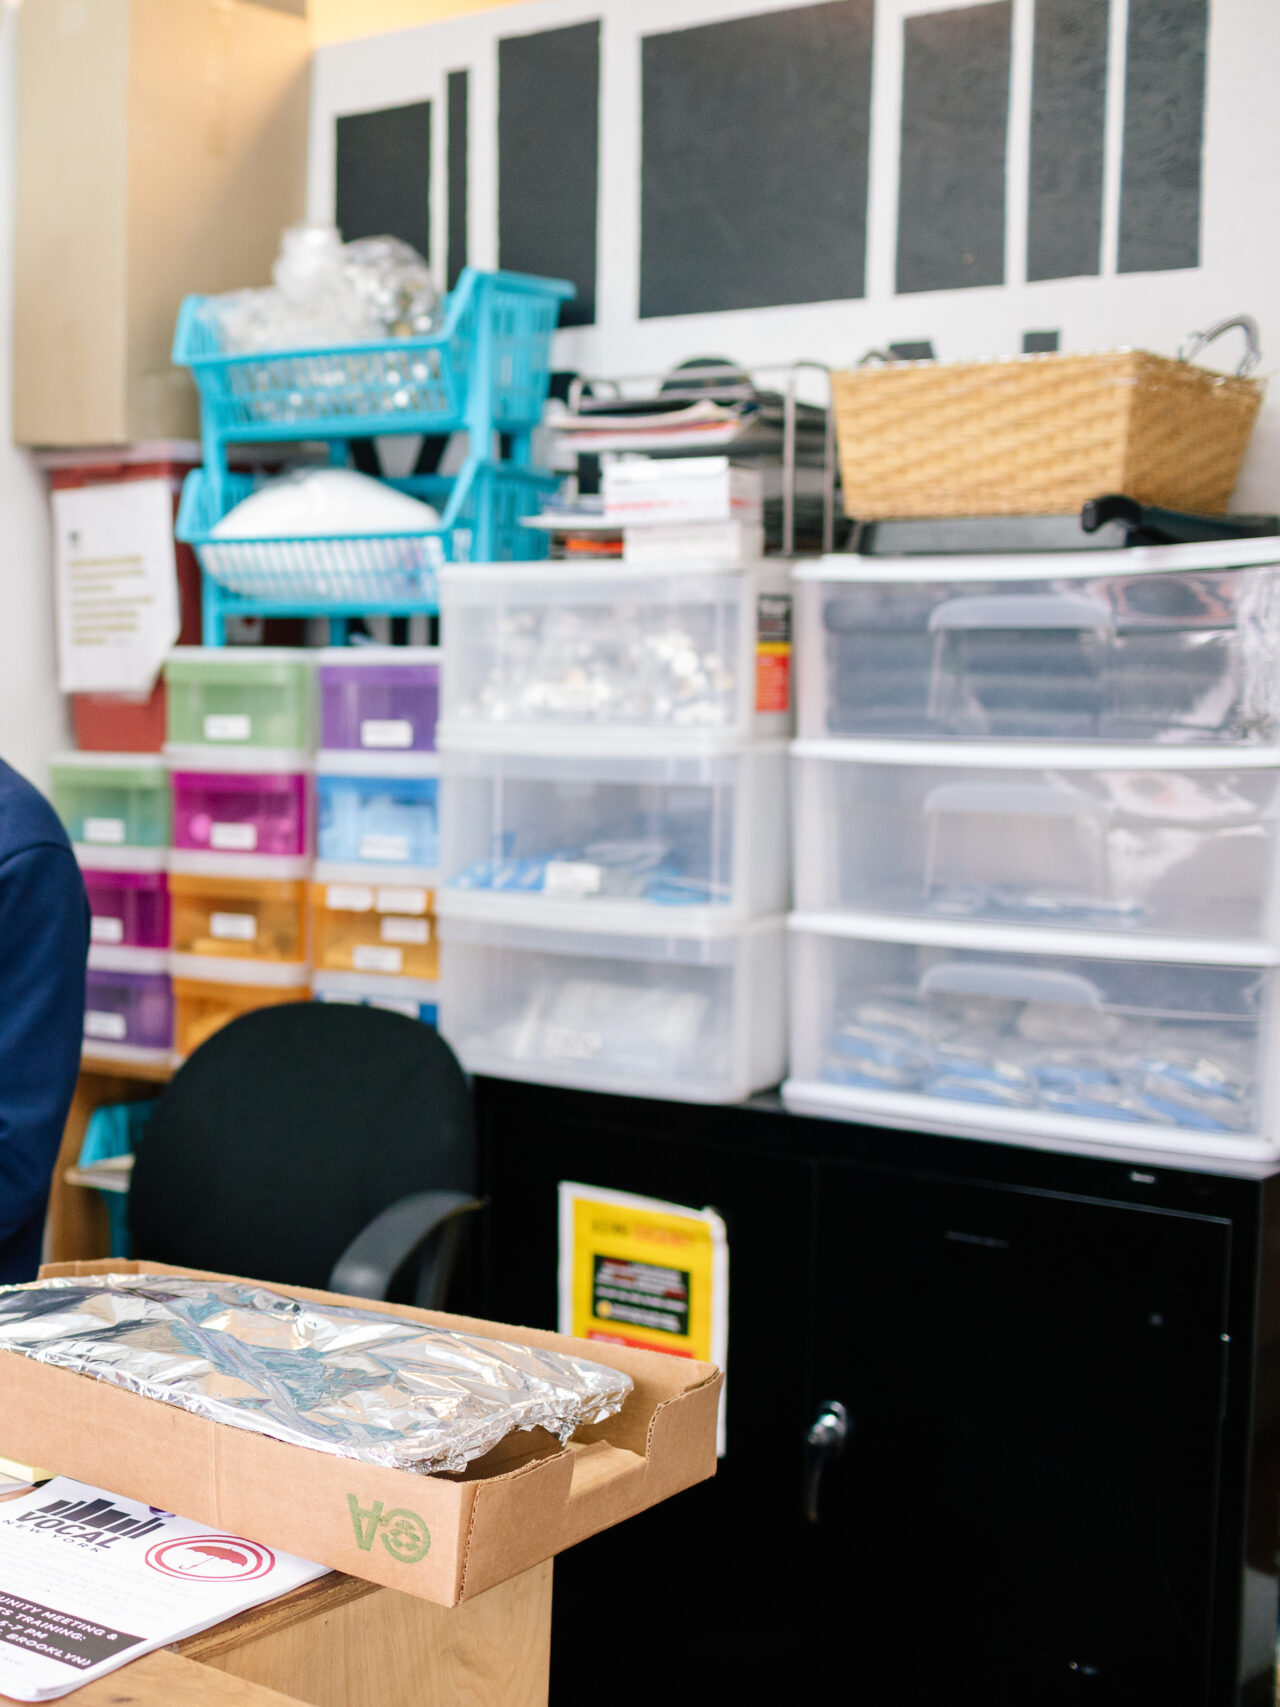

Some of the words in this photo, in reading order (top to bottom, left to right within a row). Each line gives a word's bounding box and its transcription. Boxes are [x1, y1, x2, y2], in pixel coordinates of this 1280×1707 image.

[2, 1519, 45, 1534] NEW
[52, 1534, 100, 1553] YORK
[16, 1511, 121, 1549] VOCAL
[15, 1613, 86, 1641] TRAINING:
[23, 1628, 48, 1639] PM
[41, 1611, 105, 1636] MEETING
[6, 1633, 91, 1666] BROOKLYN)
